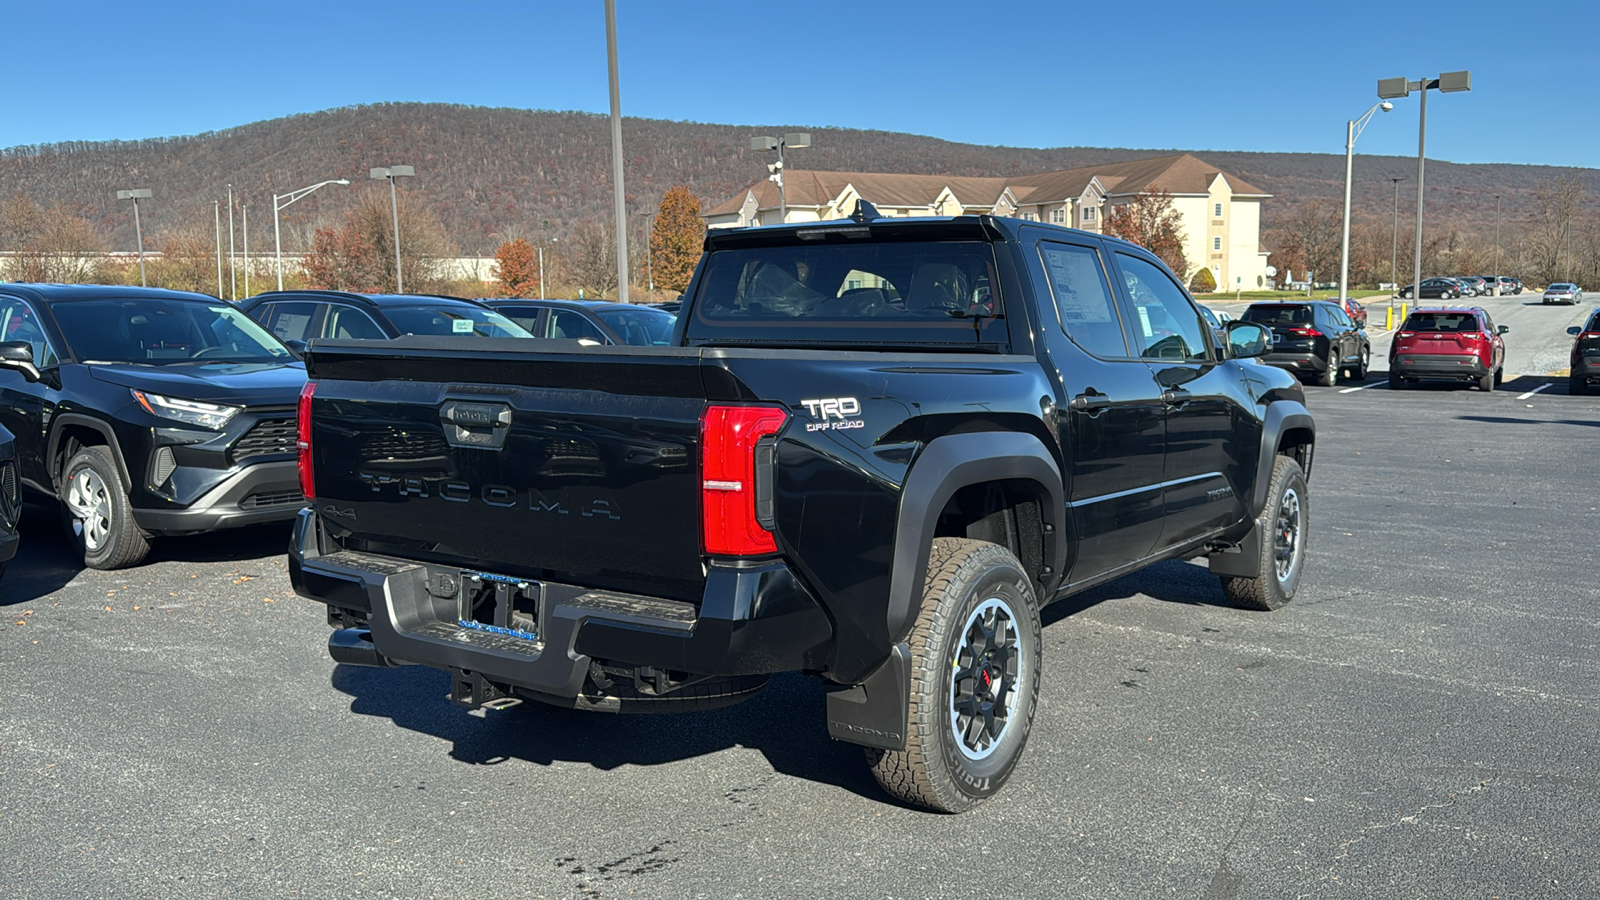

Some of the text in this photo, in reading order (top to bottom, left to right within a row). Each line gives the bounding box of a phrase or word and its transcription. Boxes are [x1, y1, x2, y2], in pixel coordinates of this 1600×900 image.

[455, 410, 488, 421] TOYOTA
[800, 397, 861, 421] TRD
[805, 420, 865, 432] OFF ROAD
[358, 471, 622, 520] TACOMA
[830, 720, 901, 741] TACOMA
